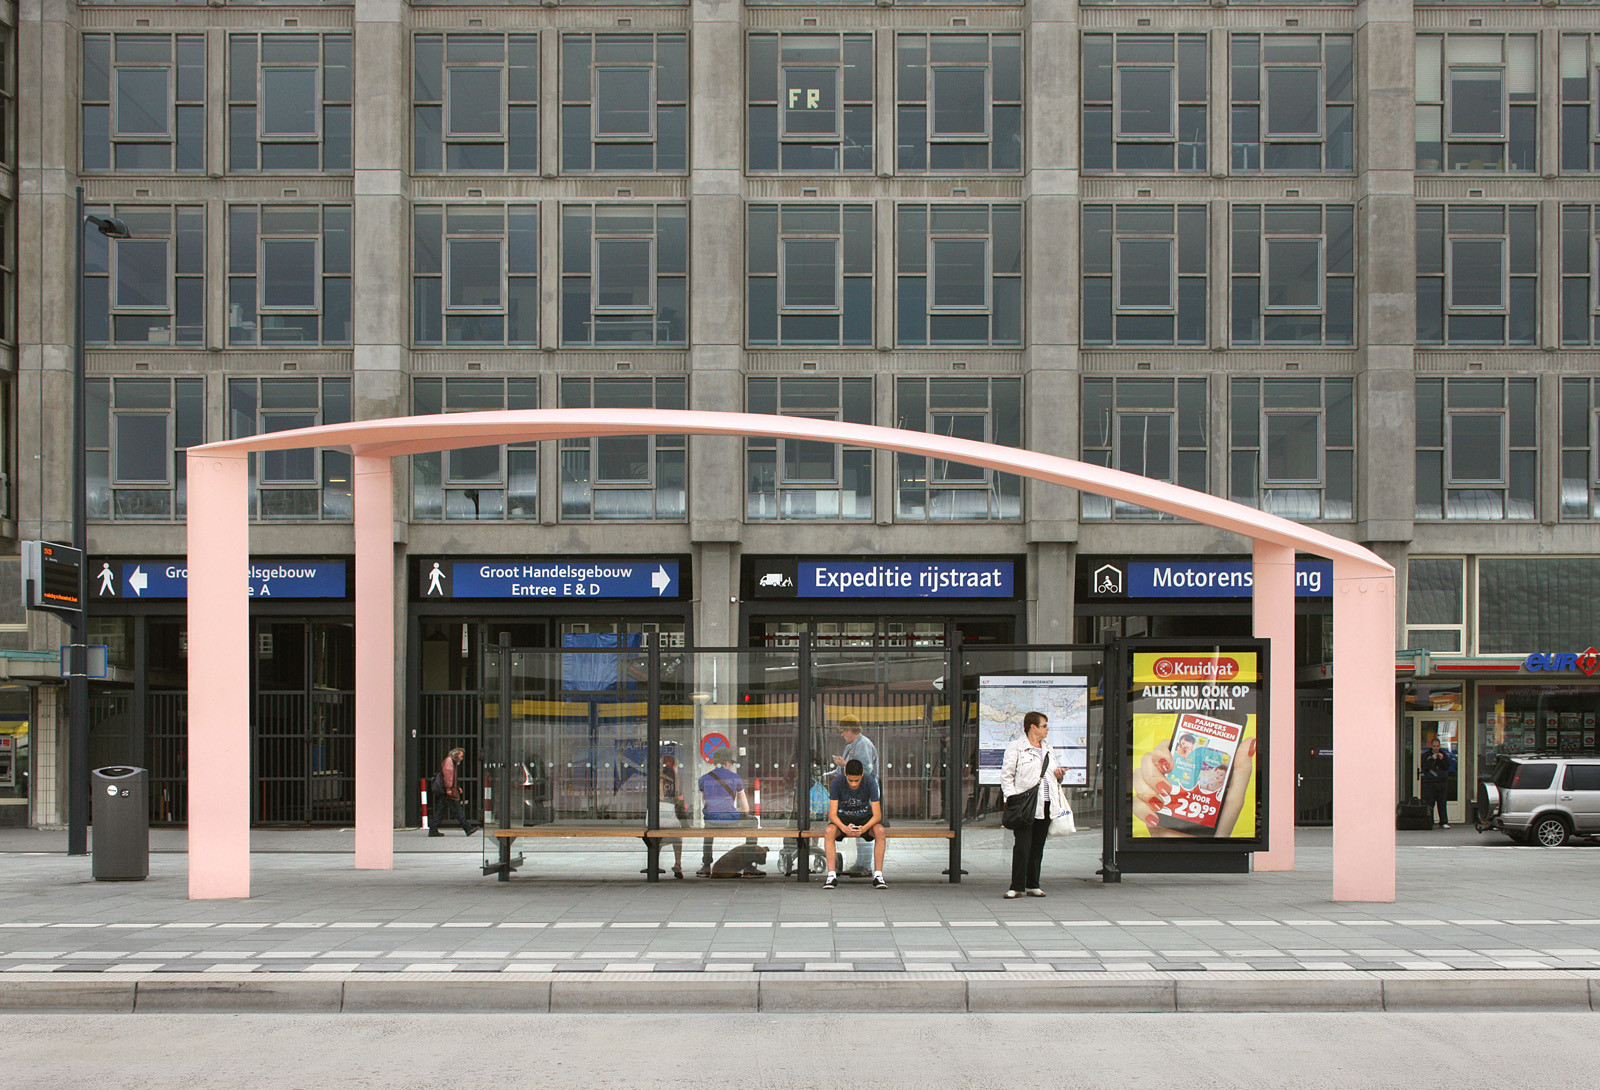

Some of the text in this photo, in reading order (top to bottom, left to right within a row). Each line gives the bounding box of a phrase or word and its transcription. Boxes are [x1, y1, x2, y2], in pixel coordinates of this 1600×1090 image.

[165, 566, 188, 579] Gro
[479, 564, 633, 582] Groot Handelsgebouw
[815, 566, 1002, 593] Expeditie rijstraat
[259, 584, 271, 596] A
[511, 583, 601, 596] Entree E & D
[1174, 661, 1233, 676] Kruidvat
[1142, 685, 1250, 698] ALLES NU OOK OP
[1156, 698, 1236, 711] KRUIDVAT.NL
[1182, 721, 1236, 740] REUZENPAKKEN
[1194, 718, 1227, 732] PAMPERS
[1185, 791, 1211, 804] 2 VOOR
[1174, 798, 1217, 819] 29.99
